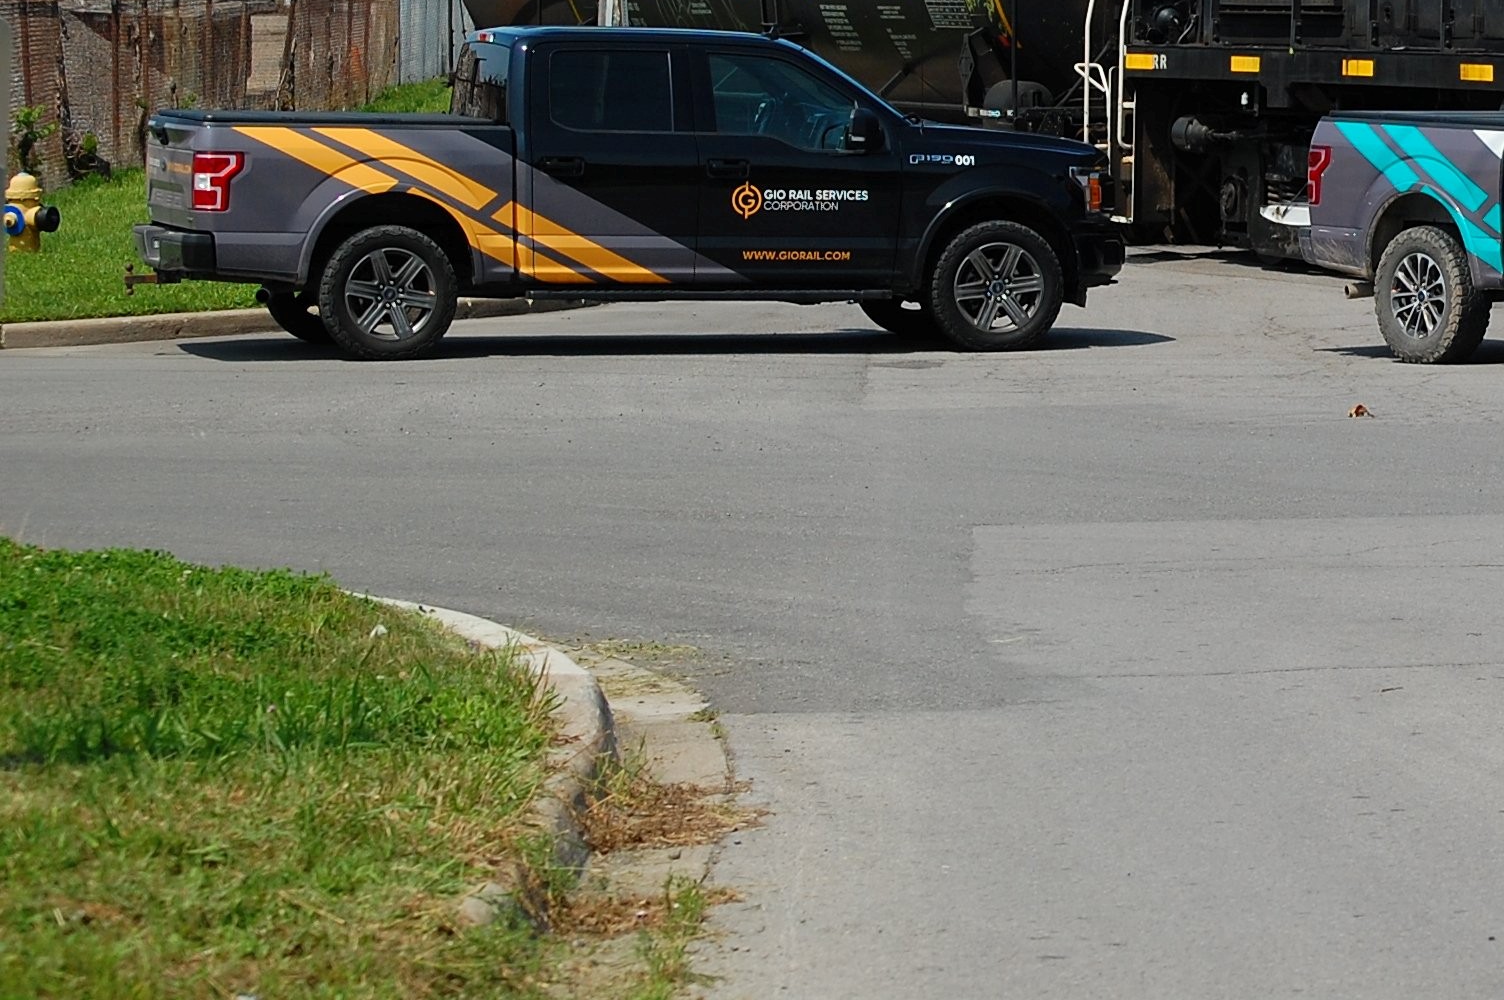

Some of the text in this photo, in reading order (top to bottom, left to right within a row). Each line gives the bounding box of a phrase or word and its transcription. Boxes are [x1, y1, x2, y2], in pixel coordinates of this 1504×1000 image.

[955, 154, 975, 166] 001
[763, 189, 869, 201] GIO RAIL SERVICES
[763, 200, 839, 211] CORPORATION
[742, 250, 850, 261] WWW.GIORAIL.COM
